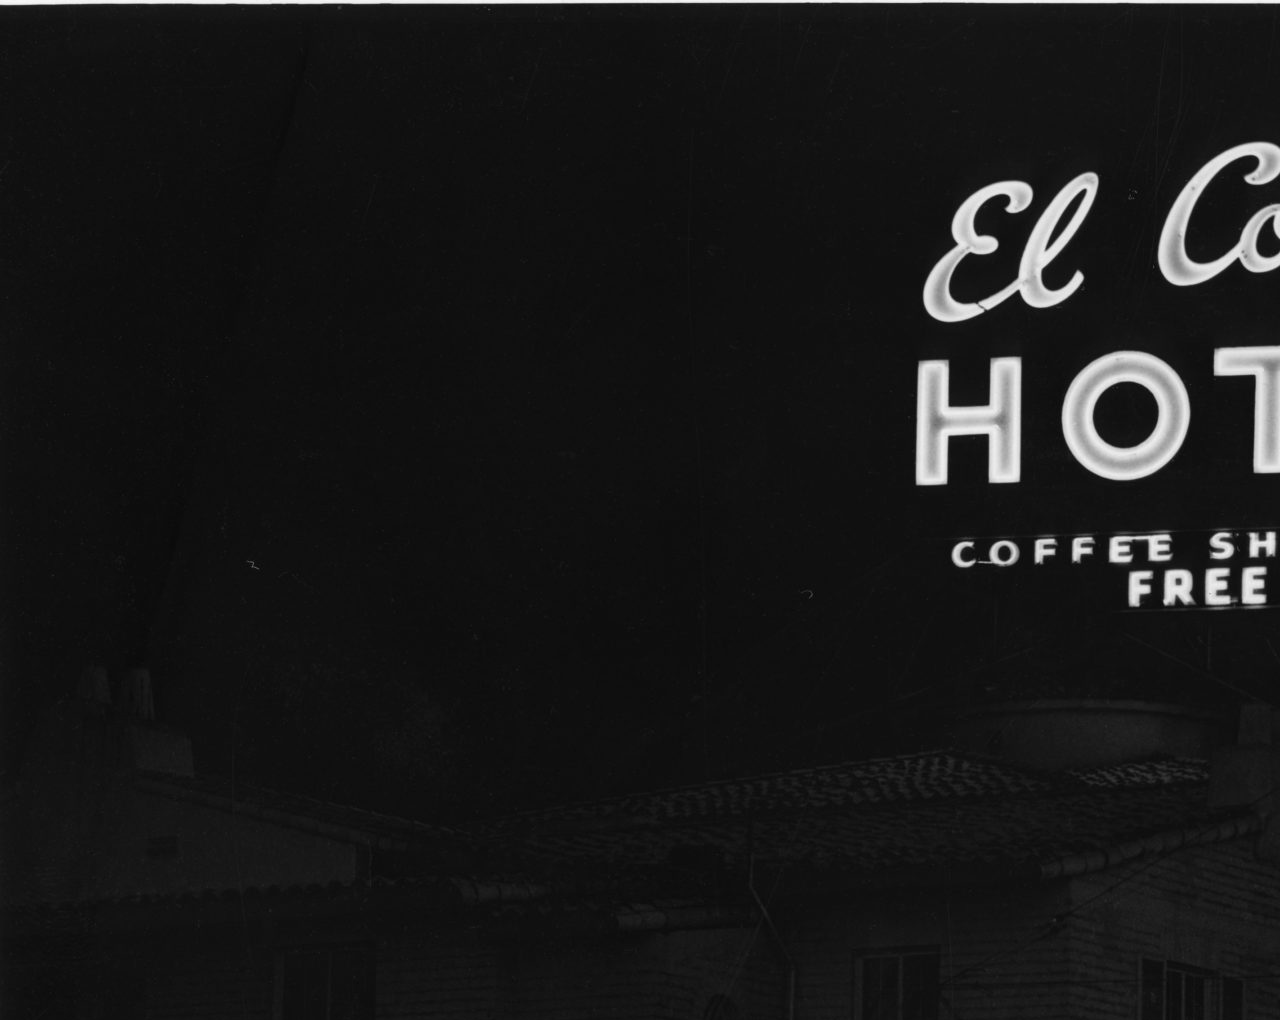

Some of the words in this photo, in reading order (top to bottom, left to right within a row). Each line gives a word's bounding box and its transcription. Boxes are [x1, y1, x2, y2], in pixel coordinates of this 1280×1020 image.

[922, 171, 1099, 323] El
[951, 531, 1174, 568] COFFEE
[1127, 567, 1268, 607] FREE
